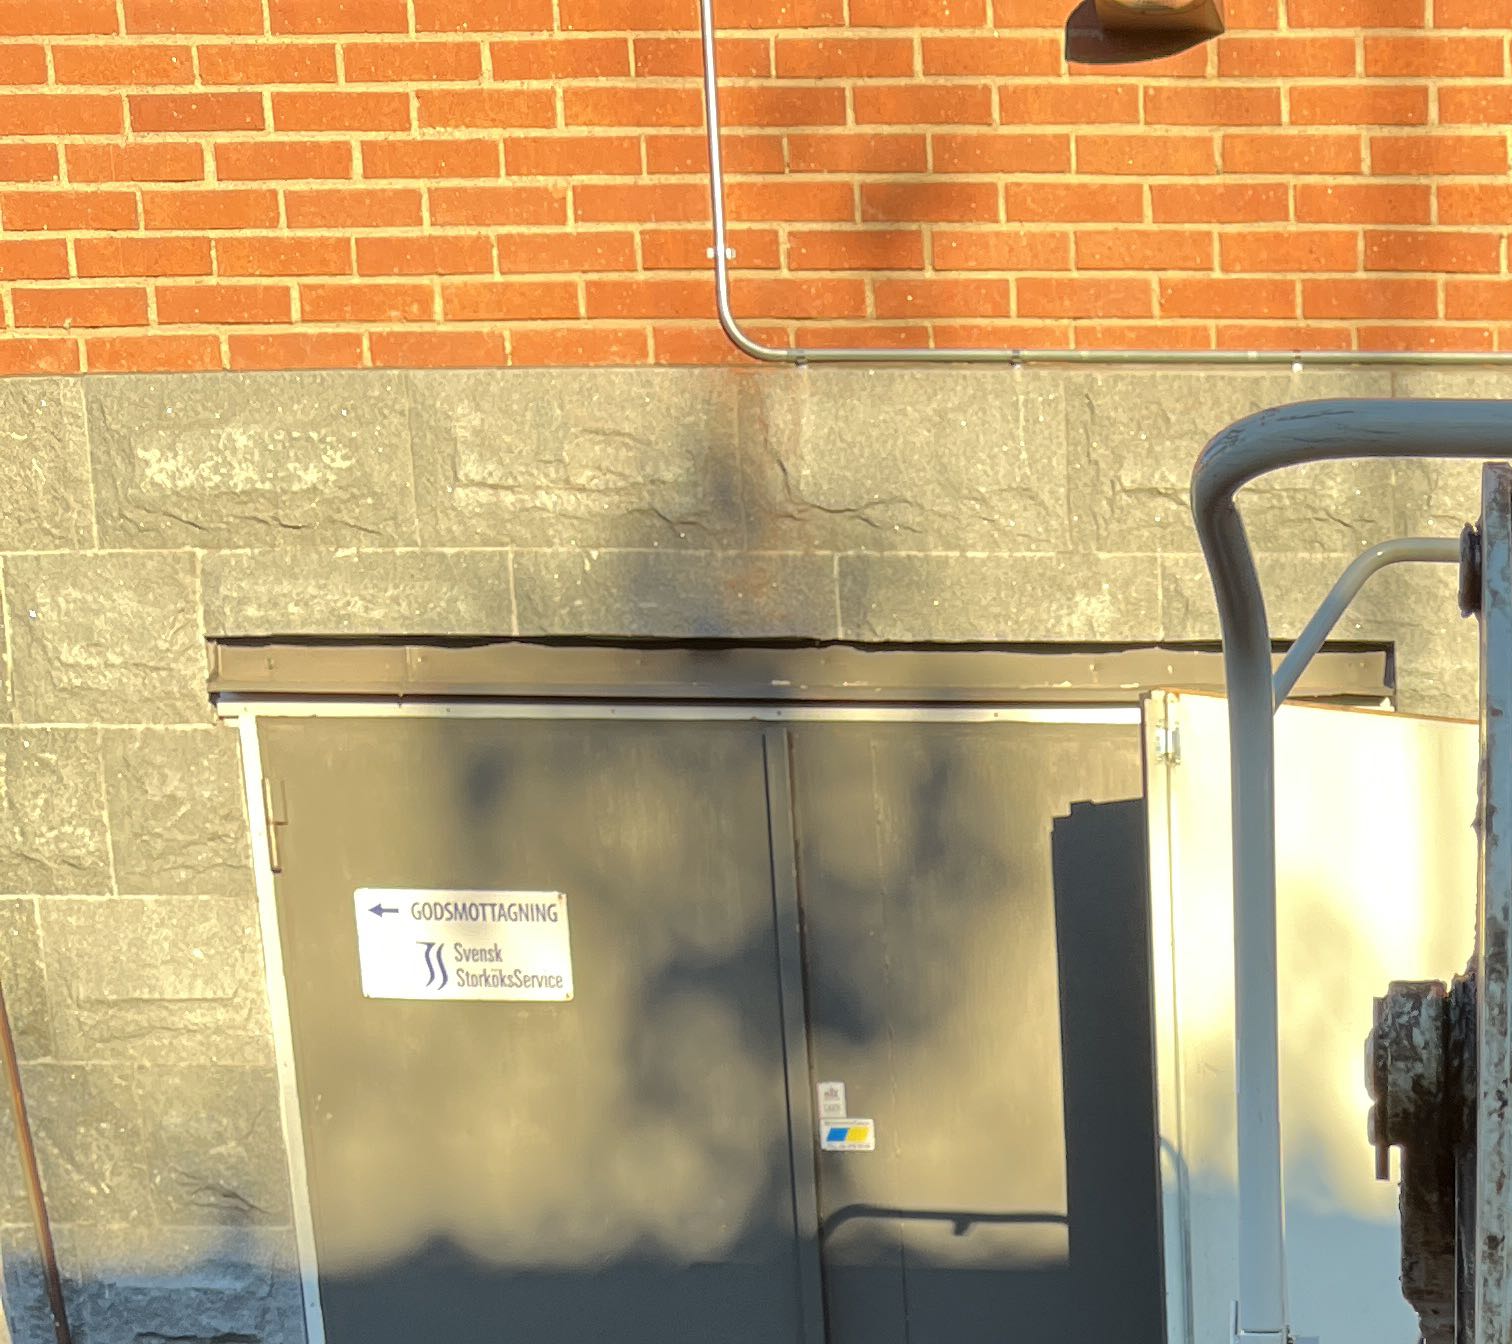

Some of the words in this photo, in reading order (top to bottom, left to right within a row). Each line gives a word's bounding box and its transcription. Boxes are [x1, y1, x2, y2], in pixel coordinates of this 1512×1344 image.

[410, 901, 559, 923] GODSMOTTAGNING
[454, 942, 503, 963] Svensk
[456, 967, 563, 989] StorköksService
